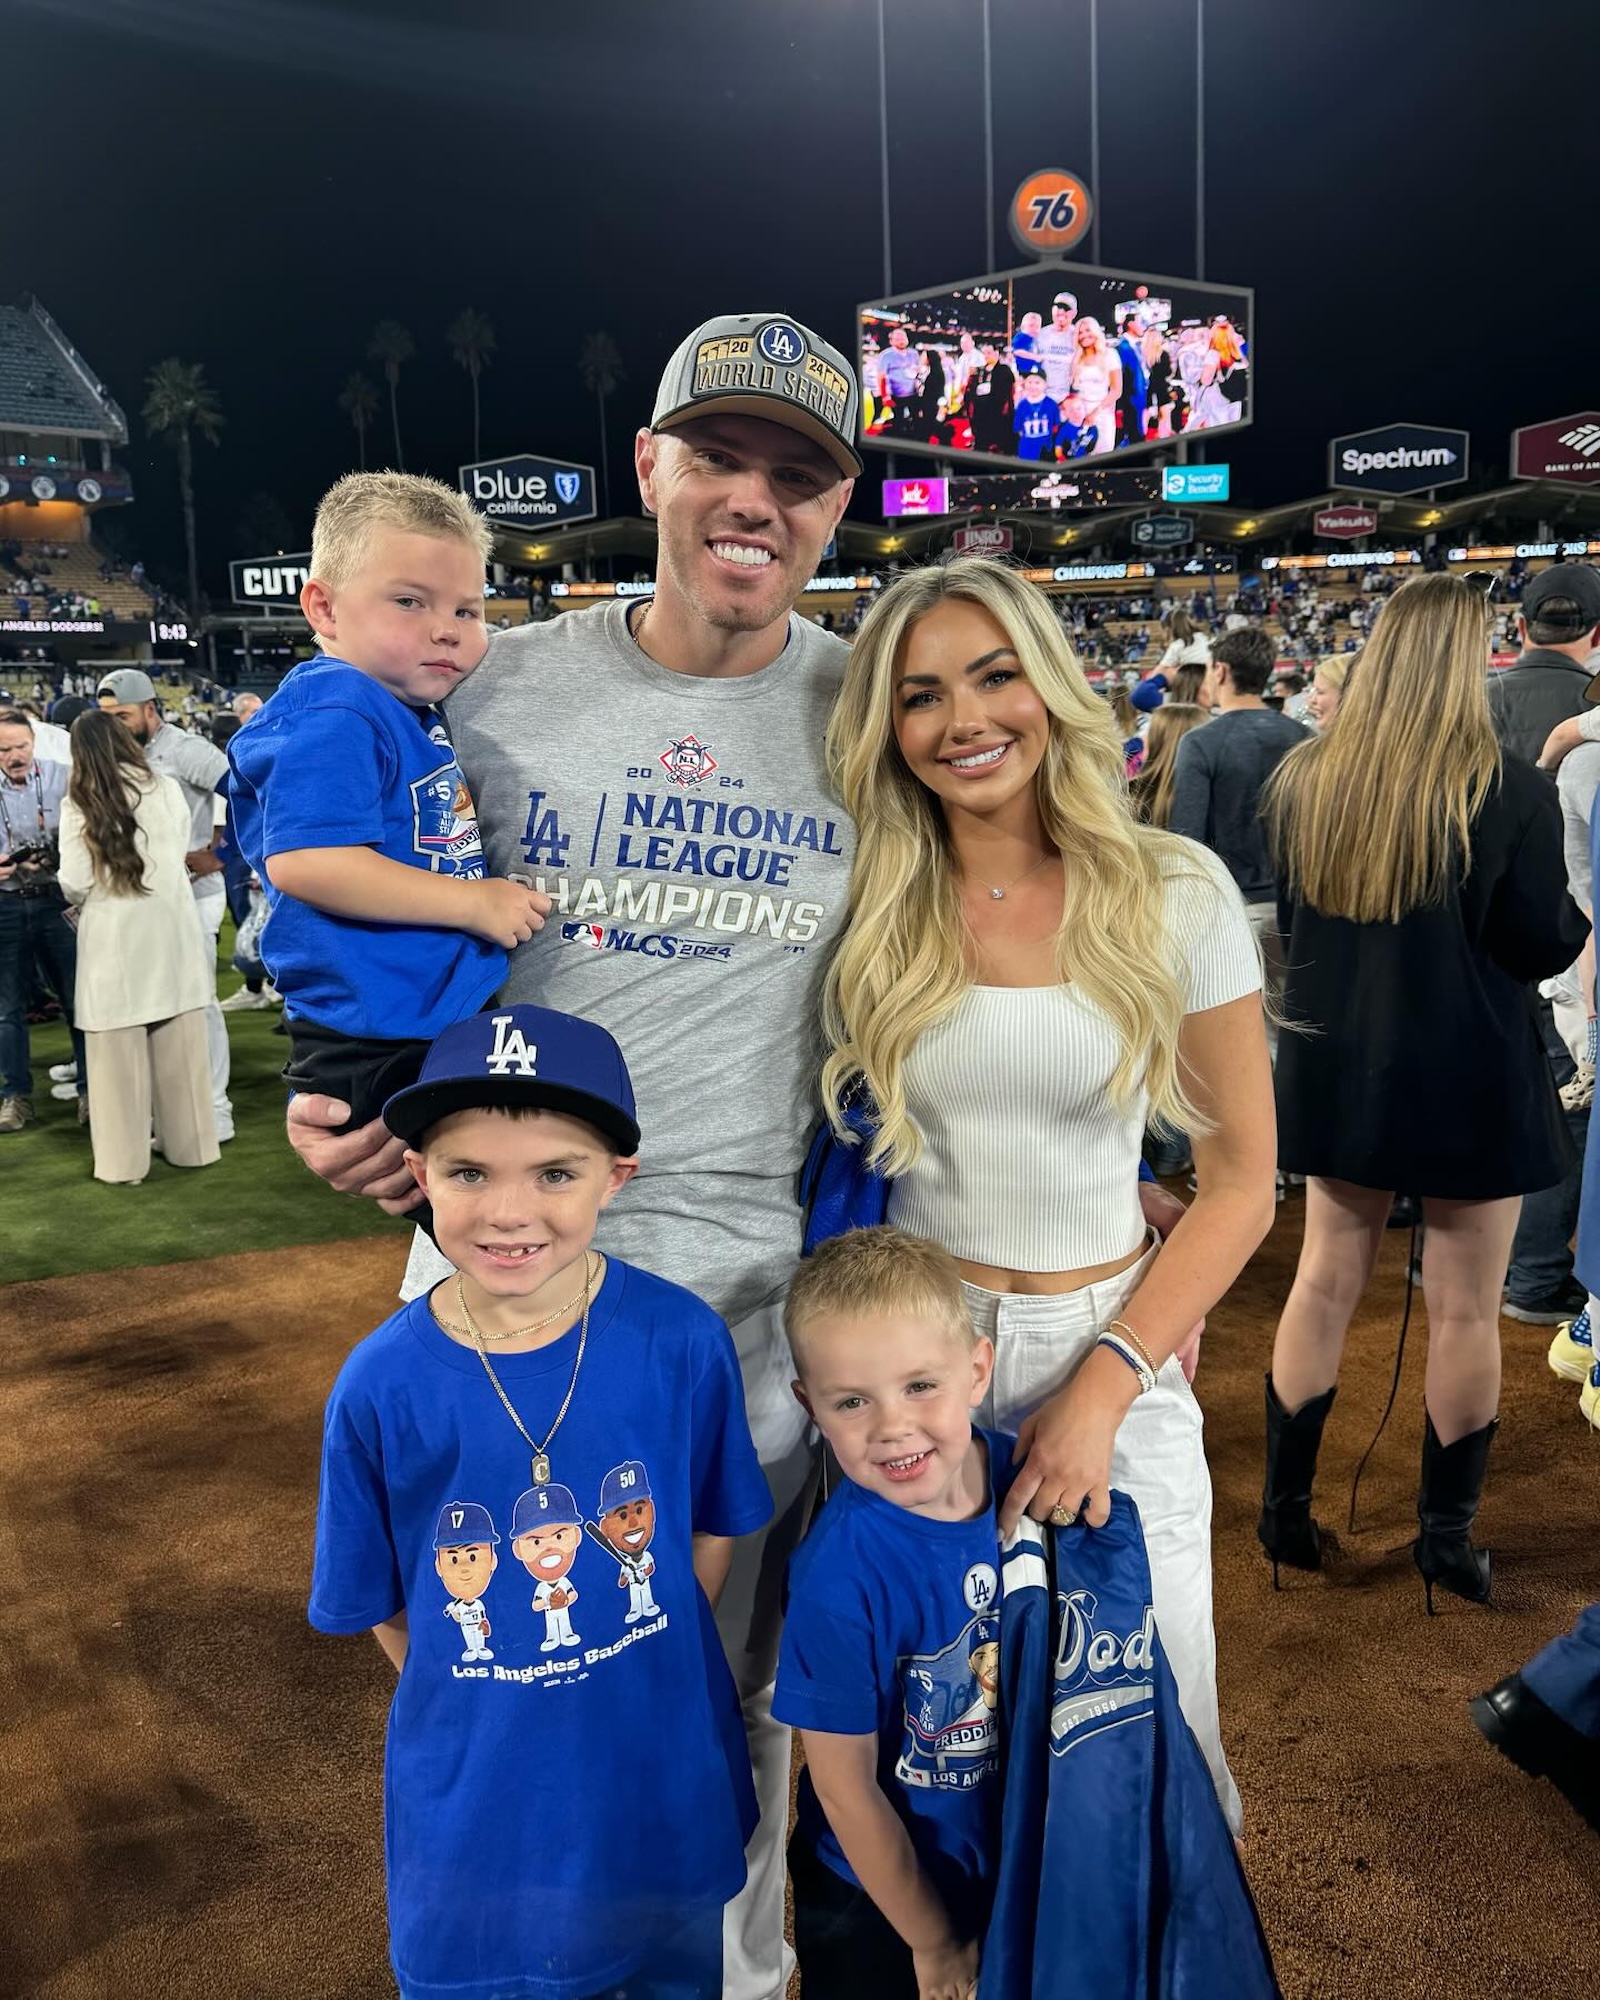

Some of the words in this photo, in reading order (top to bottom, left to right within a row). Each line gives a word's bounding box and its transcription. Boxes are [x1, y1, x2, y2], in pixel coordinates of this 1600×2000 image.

[1028, 191, 1076, 230] 76
[772, 327, 794, 360] LA
[731, 340, 749, 353] 20
[809, 358, 824, 377] 24
[699, 362, 776, 391] WORLD
[783, 370, 843, 428] SERIES
[1341, 447, 1449, 475] Spectrum
[1544, 464, 1570, 473] BANK
[1572, 463, 1584, 472] OF
[473, 469, 548, 500] blue
[486, 501, 558, 515] california
[965, 530, 1004, 547] JINRO
[1054, 564, 1128, 581] CHAMPIONS
[2, 620, 50, 632] ANGELES
[626, 767, 652, 778] 20
[719, 776, 745, 789] 24
[520, 790, 571, 868] LA
[622, 792, 843, 857] NATIONAL
[616, 833, 796, 887] LEAGUE
[605, 928, 679, 959] NLCS
[680, 944, 732, 959] 2024
[485, 1015, 538, 1077] LA
[619, 1469, 636, 1490] 50
[538, 1491, 549, 1510] 5
[451, 1510, 465, 1529] 17
[970, 1573, 990, 1605] LA
[978, 1623, 990, 1640] LA
[452, 1664, 490, 1678] Los
[493, 1656, 581, 1684] Angeles
[584, 1614, 668, 1665] Baseball
[934, 1723, 996, 1749] FREDDIE
[932, 1771, 958, 1785] LOS
